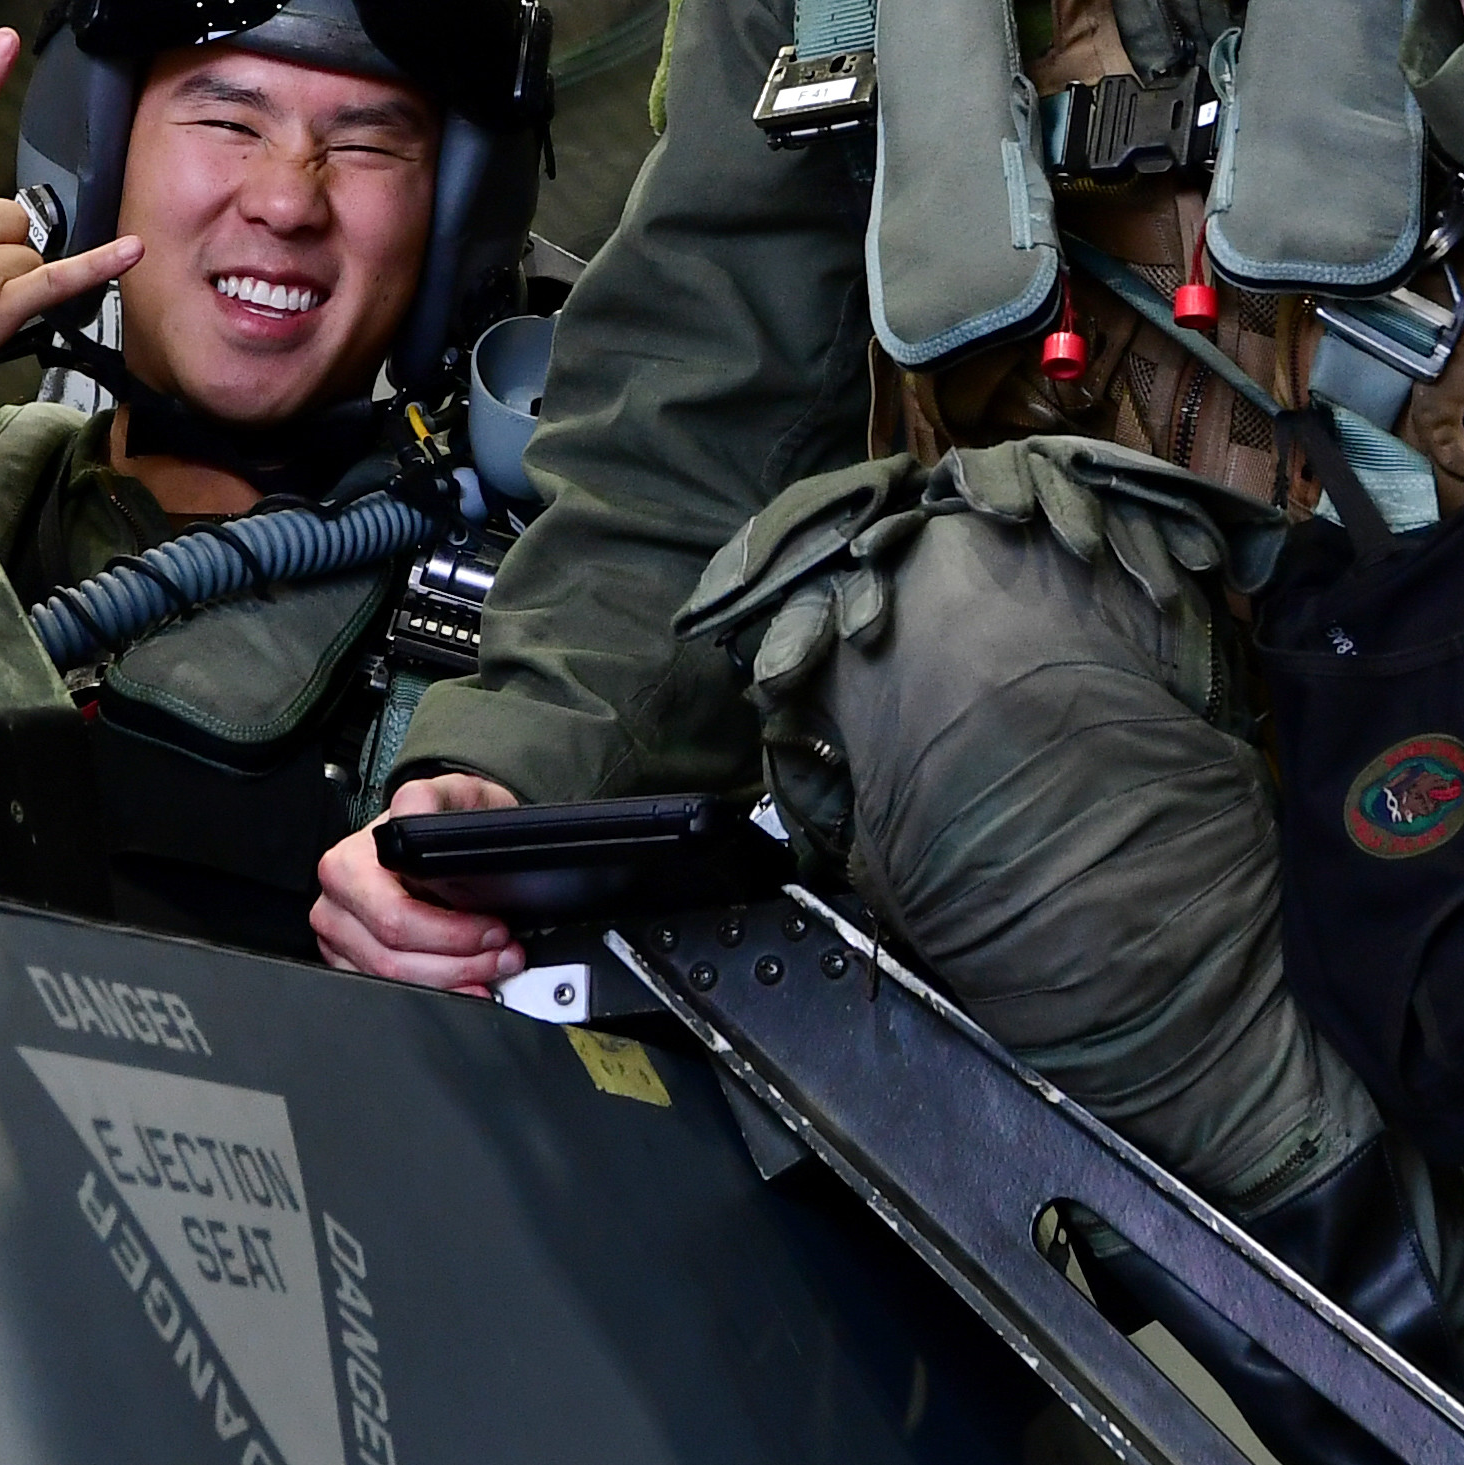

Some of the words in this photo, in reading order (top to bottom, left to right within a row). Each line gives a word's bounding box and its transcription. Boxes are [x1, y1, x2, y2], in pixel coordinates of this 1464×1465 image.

[27, 966, 212, 1056] DANGER
[92, 1118, 300, 1213] EJECTION
[181, 1215, 287, 1293] SEAT
